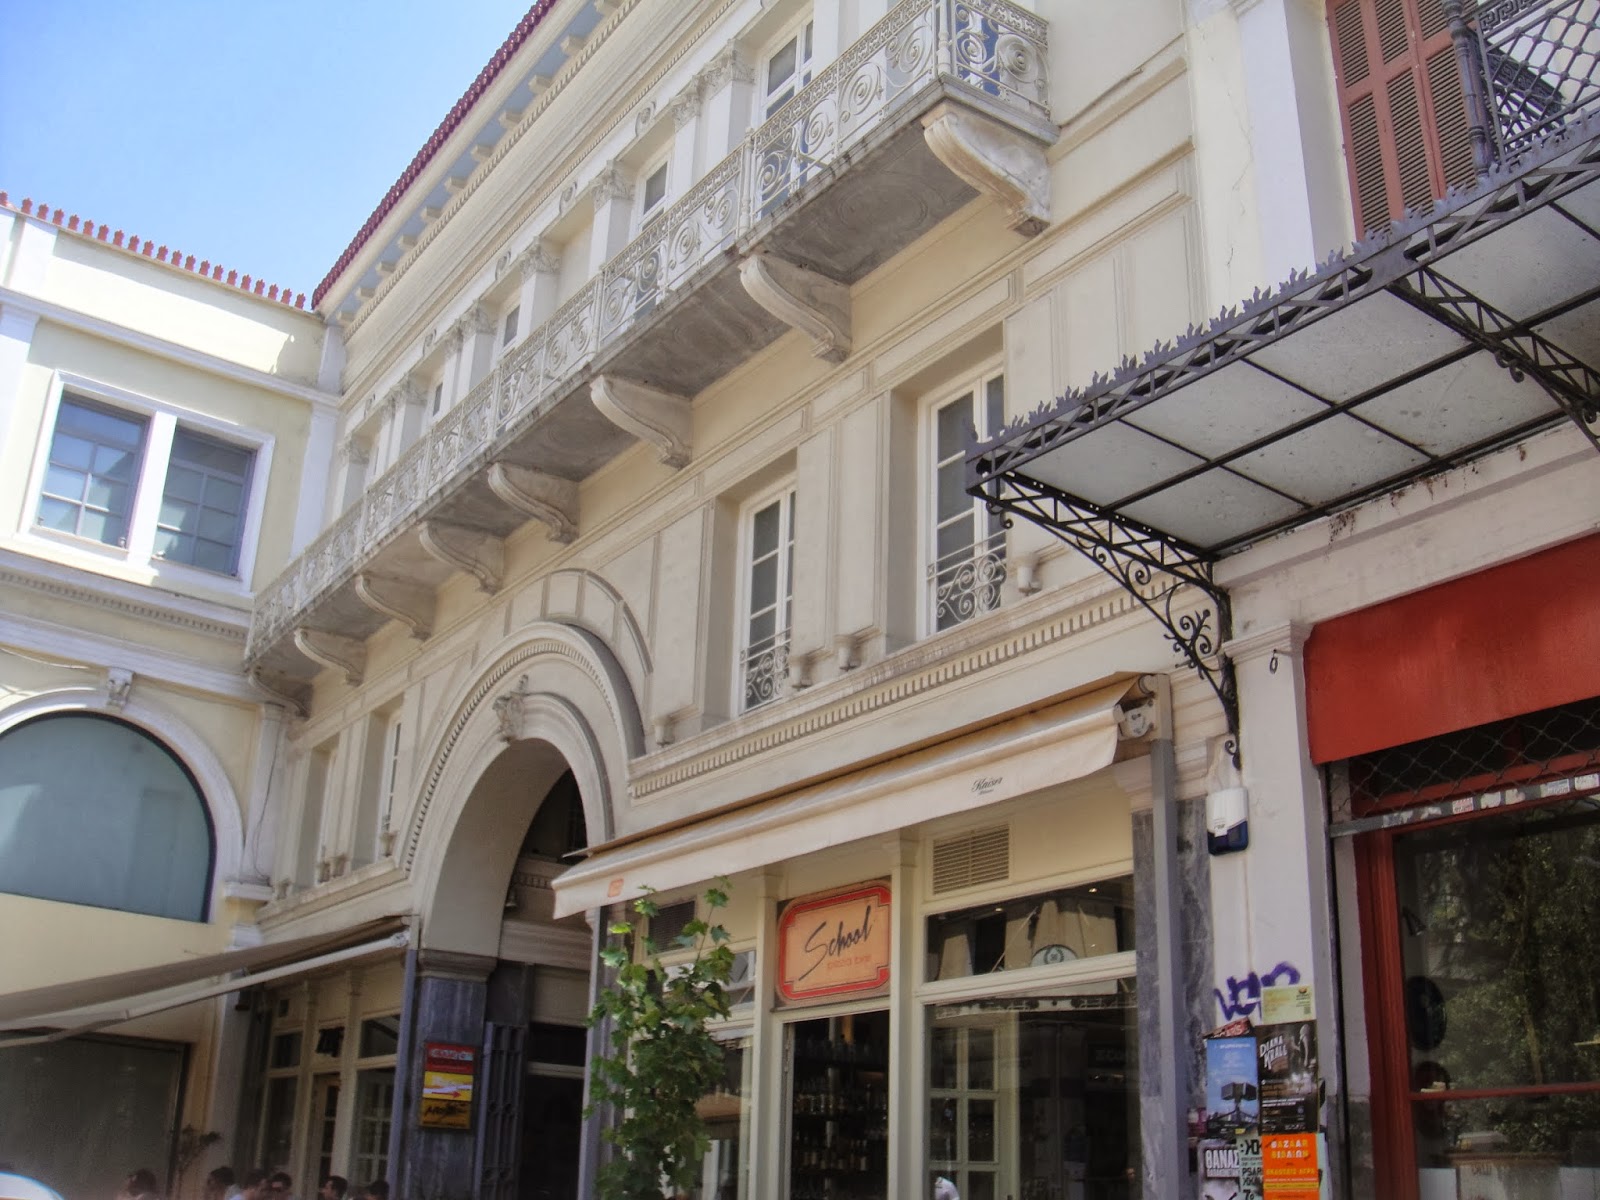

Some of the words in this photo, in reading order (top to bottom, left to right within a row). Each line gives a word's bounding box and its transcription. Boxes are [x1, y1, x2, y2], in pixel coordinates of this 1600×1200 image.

[799, 905, 870, 981] School
[1259, 1036, 1283, 1058] DIANA
[1263, 1045, 1288, 1070] KRALL
